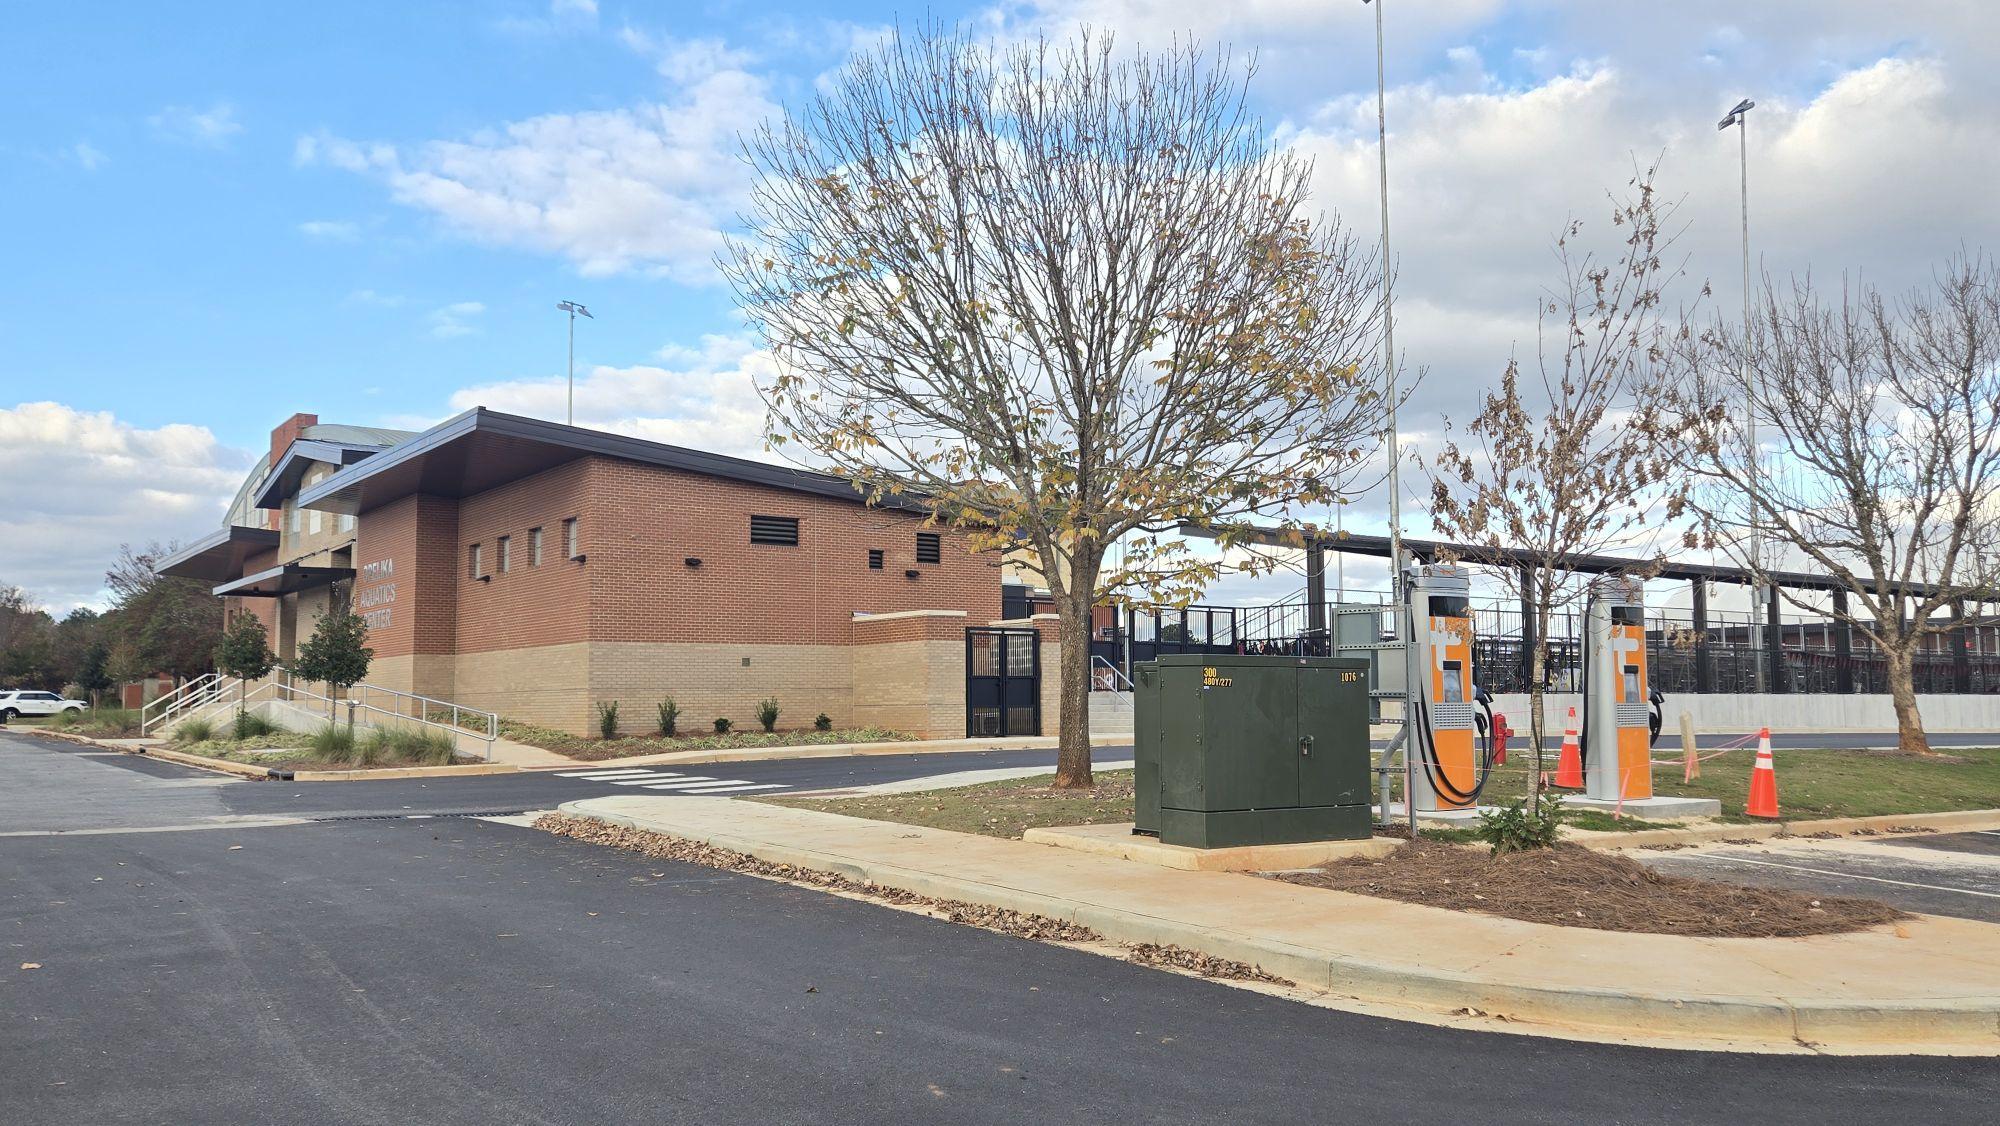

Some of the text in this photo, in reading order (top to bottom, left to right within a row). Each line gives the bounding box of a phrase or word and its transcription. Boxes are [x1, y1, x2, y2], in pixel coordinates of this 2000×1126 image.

[360, 583, 396, 608] AQUATICS
[1203, 667, 1217, 678] 300
[1341, 672, 1357, 682] 1076
[1203, 677, 1233, 687] 480Y/277
